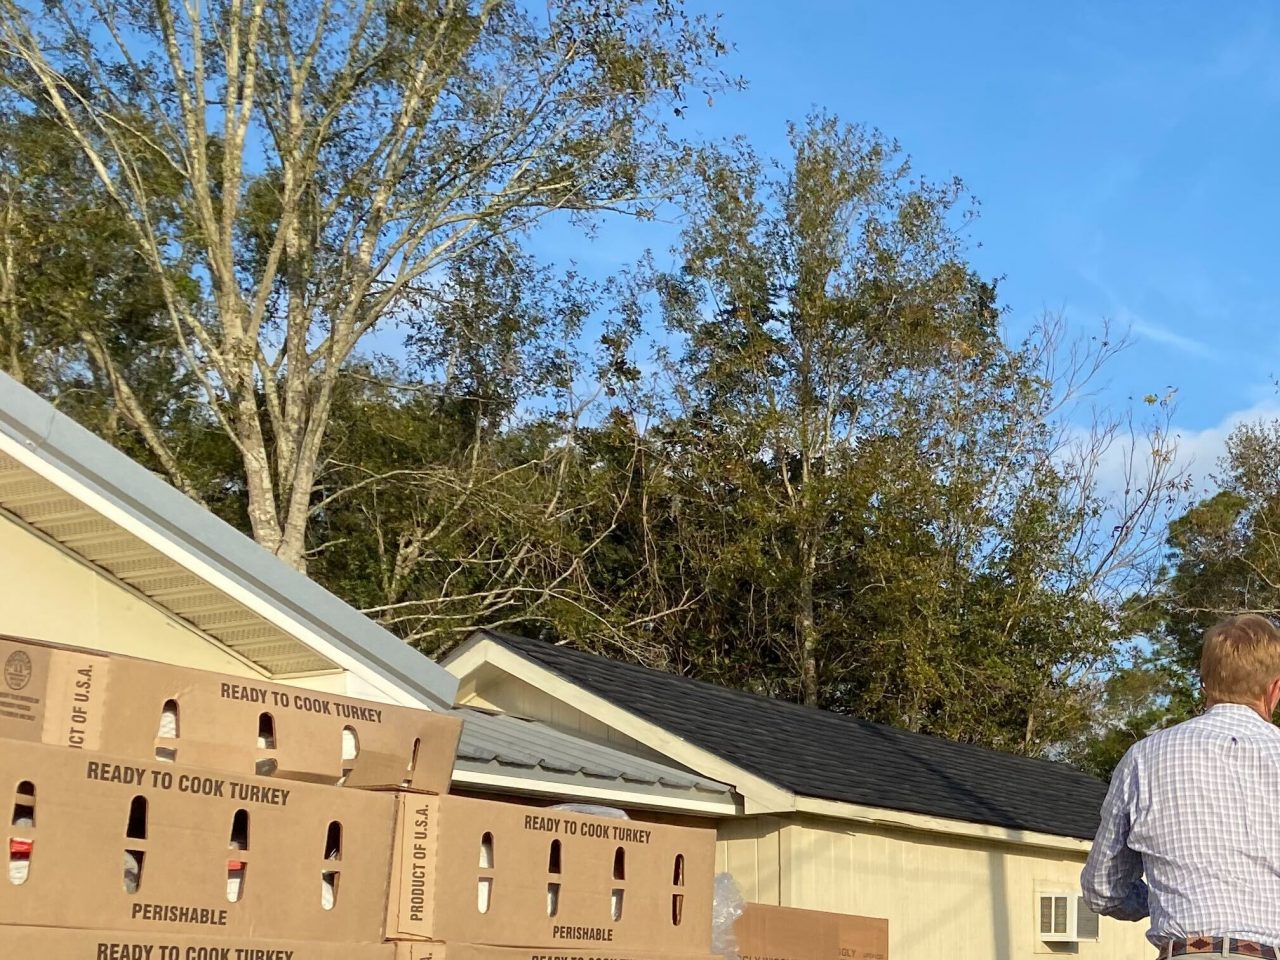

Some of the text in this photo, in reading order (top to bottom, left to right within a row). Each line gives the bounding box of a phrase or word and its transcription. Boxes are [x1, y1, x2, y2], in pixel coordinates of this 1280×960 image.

[74, 665, 93, 702] U.S.A.
[72, 706, 87, 723] OF
[221, 682, 382, 724] READY TO COOK TURKEY
[87, 761, 290, 806] READY TO COOK TURKEY
[524, 814, 651, 844] READY TO COOK TURKEY
[410, 804, 429, 921] PRODUCT OF U.S.A.
[131, 903, 228, 926] PERISHABLE
[552, 926, 613, 942] PERISHABLE
